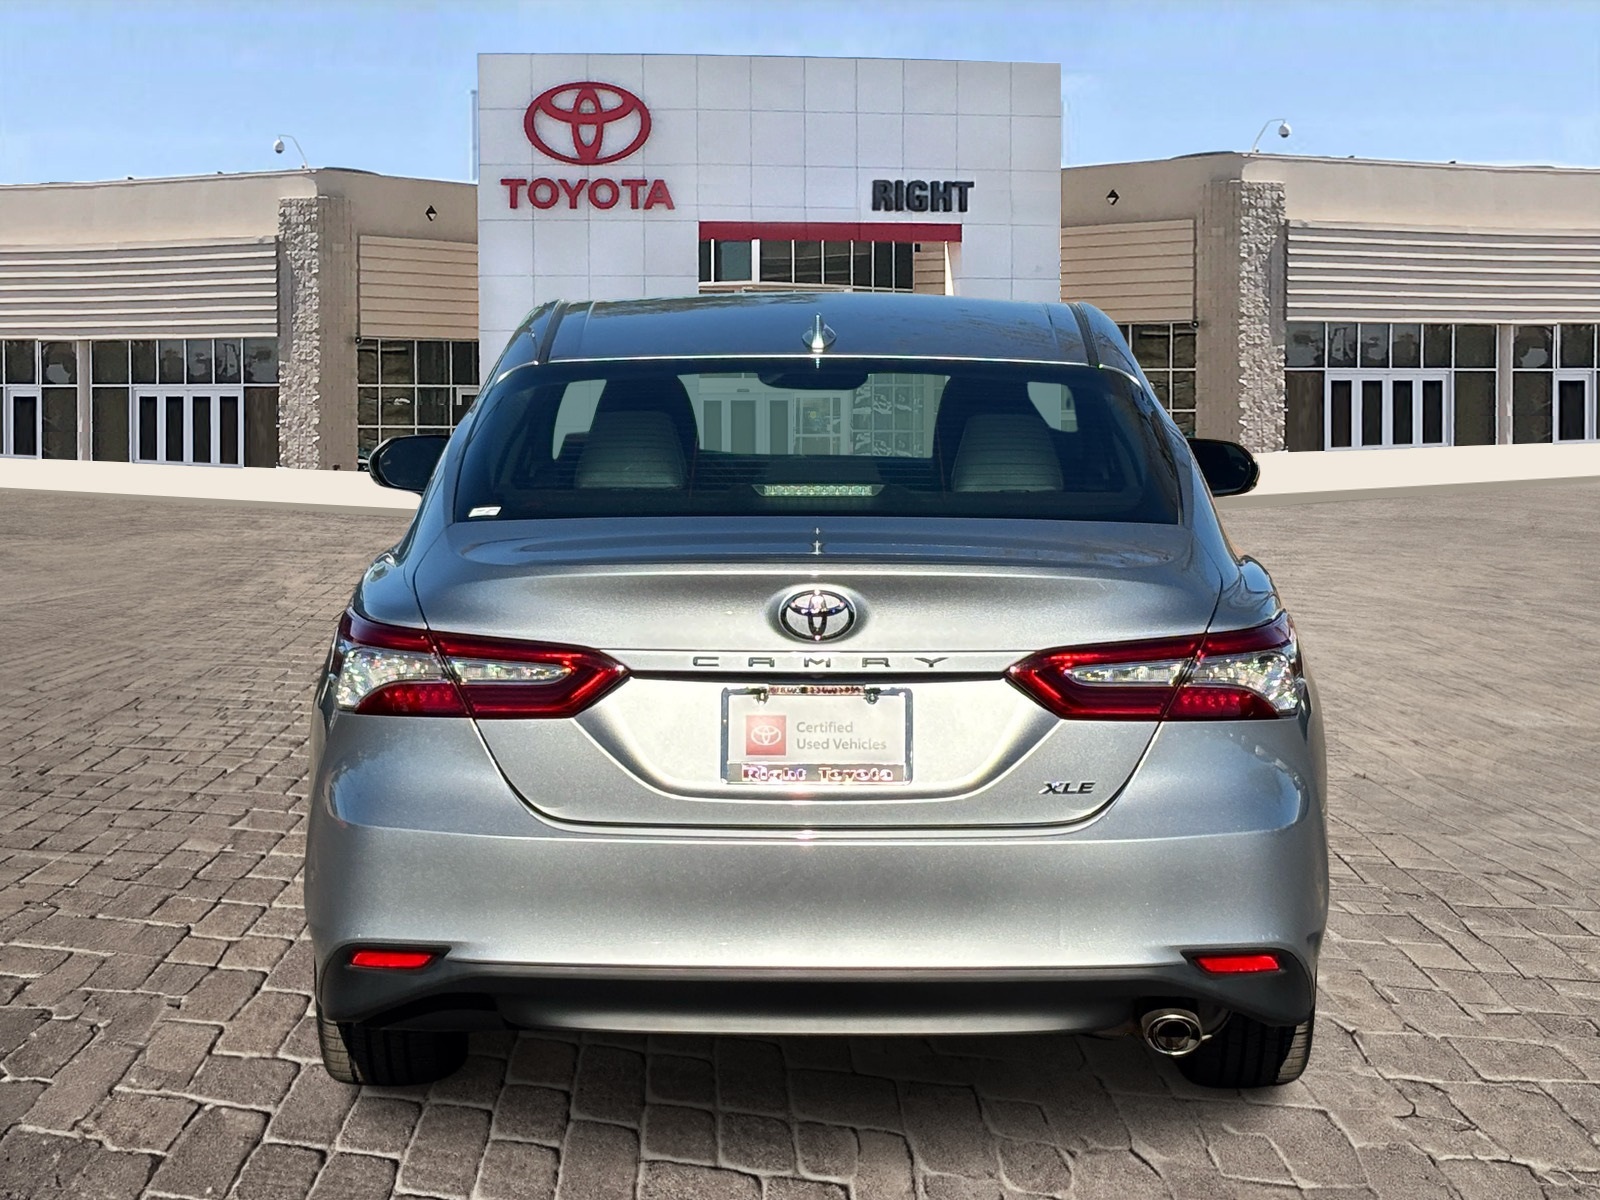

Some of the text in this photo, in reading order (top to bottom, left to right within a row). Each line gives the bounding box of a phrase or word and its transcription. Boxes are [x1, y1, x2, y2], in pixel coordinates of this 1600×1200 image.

[500, 178, 675, 210] TOYOTA
[872, 179, 975, 212] RIGHT
[693, 656, 949, 668] CAMRY
[796, 721, 854, 733] Certified
[796, 738, 887, 750] Used Vehicles
[1039, 781, 1096, 794] XLE
